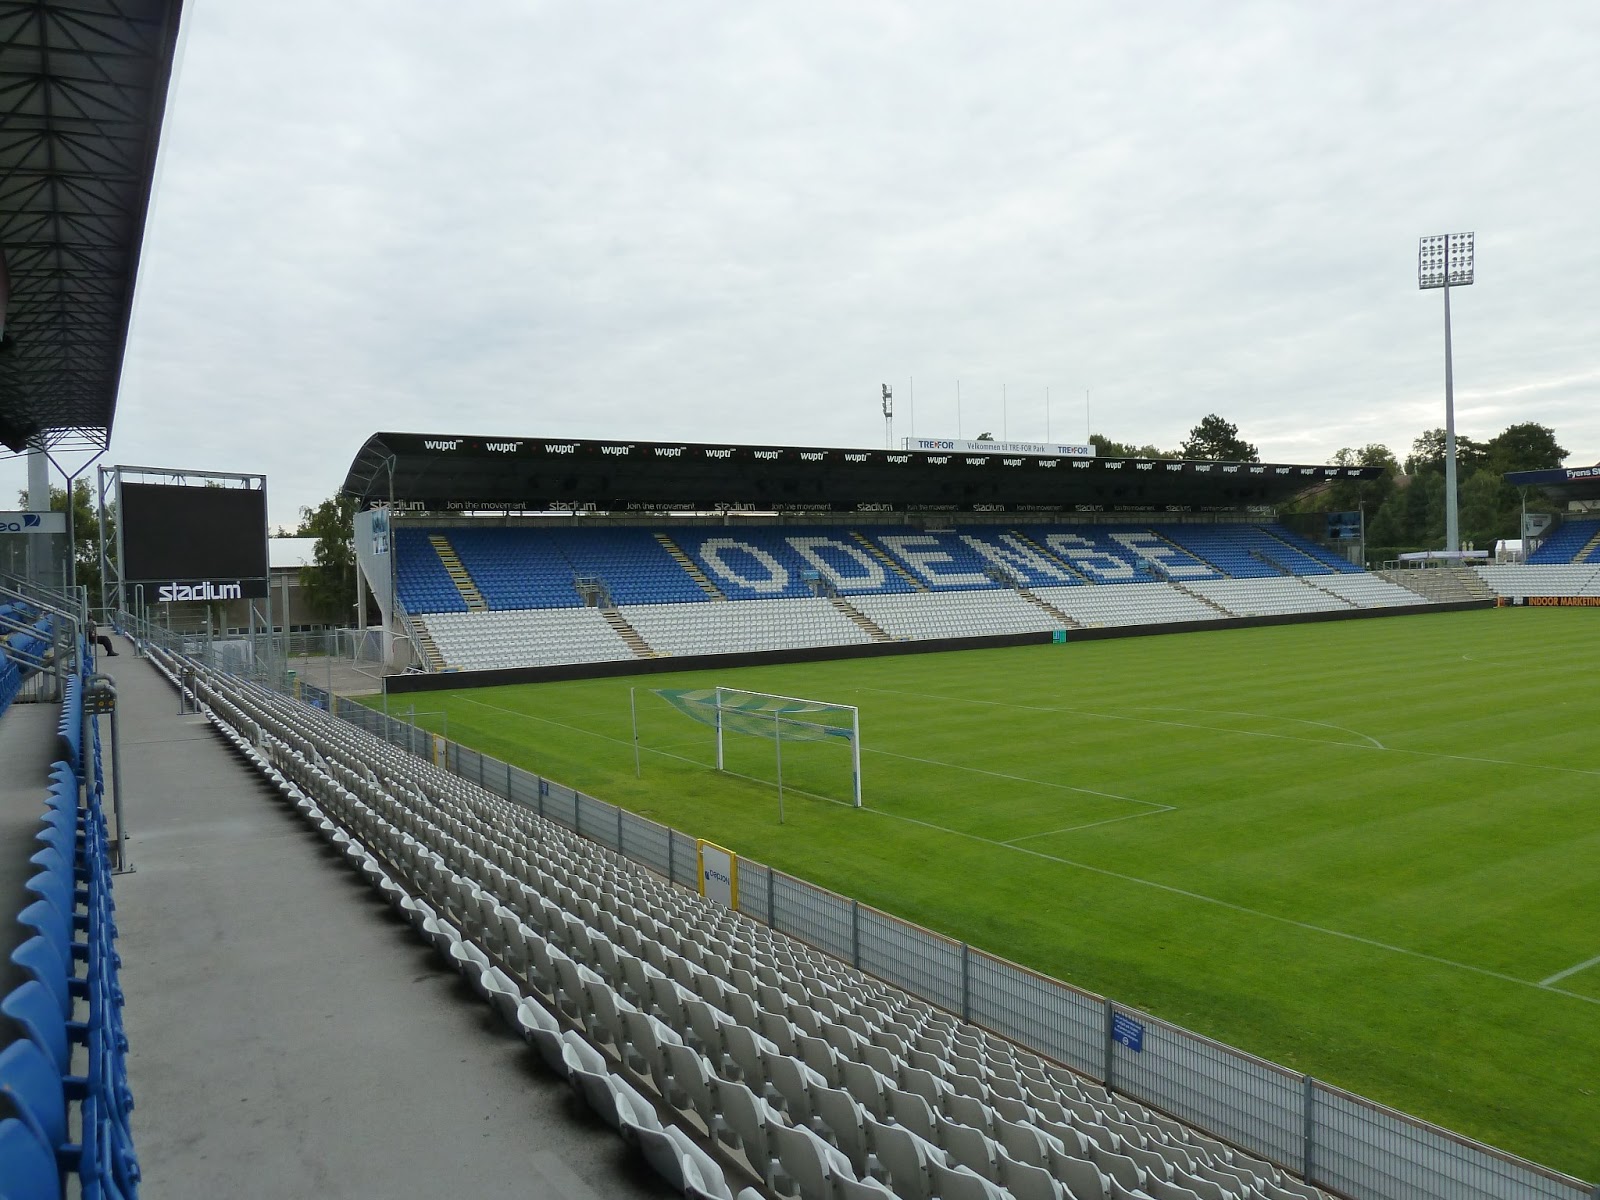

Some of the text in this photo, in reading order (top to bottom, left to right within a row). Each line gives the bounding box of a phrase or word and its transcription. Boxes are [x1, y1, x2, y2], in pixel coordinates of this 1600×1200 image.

[967, 443, 1001, 451] Velkommen
[1033, 445, 1046, 453] Park
[1566, 469, 1591, 479] Fyens
[549, 501, 597, 511] stadium
[699, 531, 1213, 594] ODENSE
[158, 581, 242, 602] stadium
[1528, 597, 1559, 606] INDOOR
